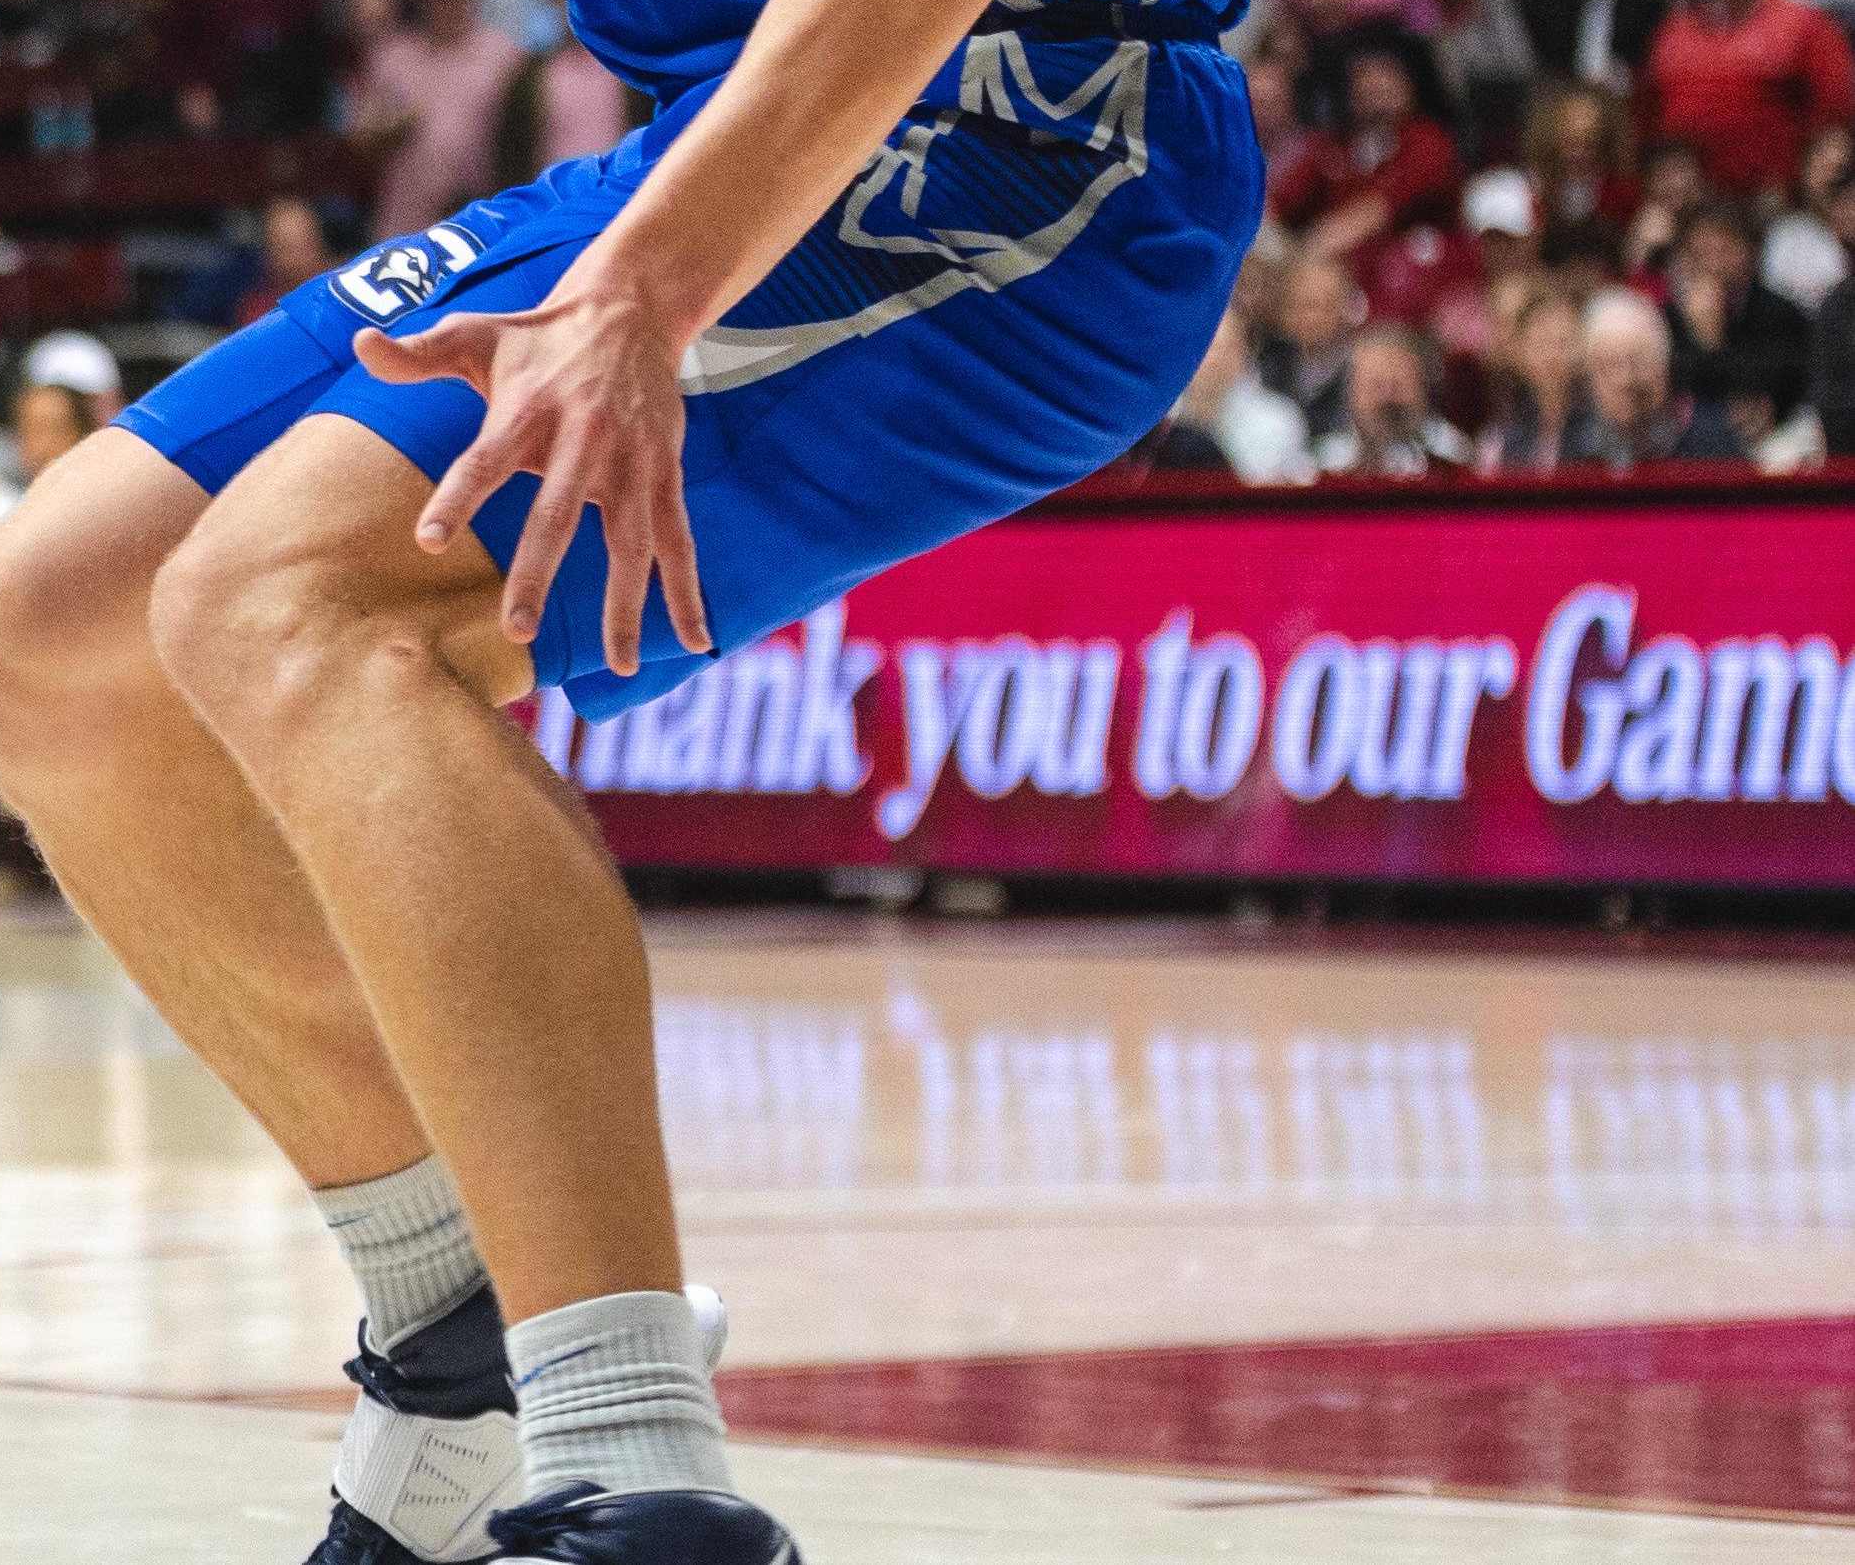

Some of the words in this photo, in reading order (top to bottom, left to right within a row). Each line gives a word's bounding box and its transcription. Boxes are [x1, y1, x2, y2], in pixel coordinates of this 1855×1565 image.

[876, 632, 1122, 841] you
[1135, 606, 1266, 803] to
[1272, 632, 1520, 804] our
